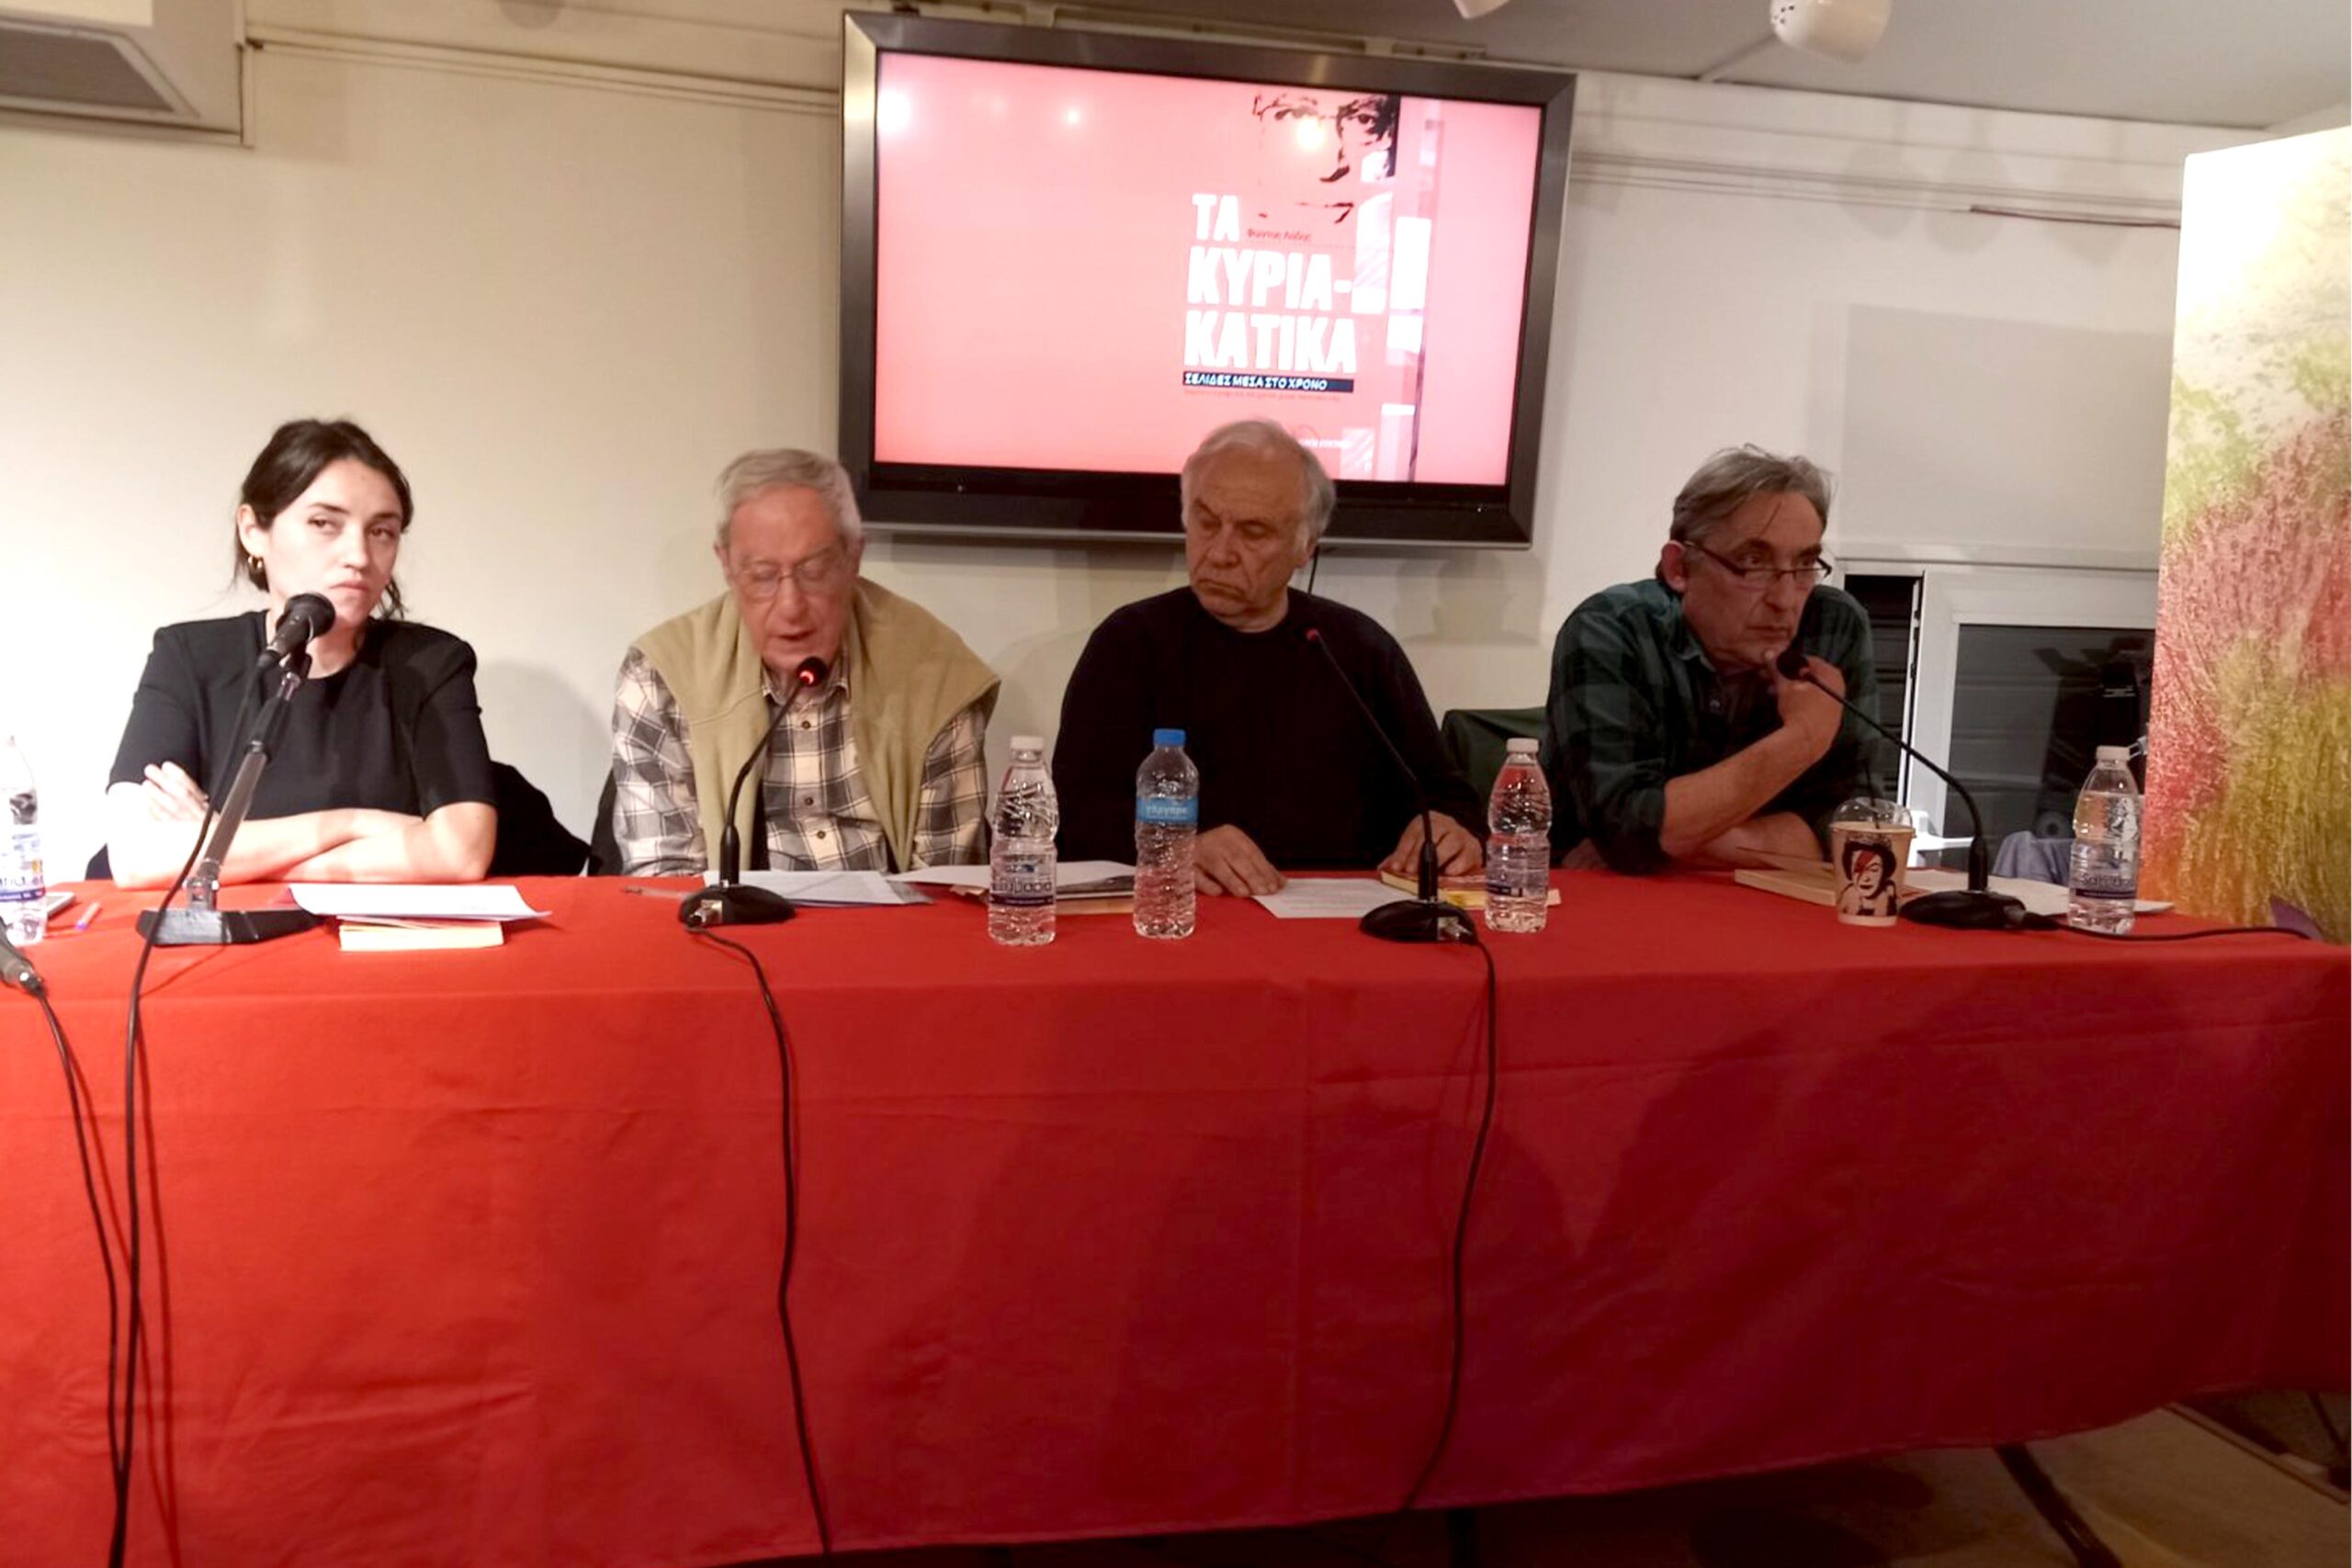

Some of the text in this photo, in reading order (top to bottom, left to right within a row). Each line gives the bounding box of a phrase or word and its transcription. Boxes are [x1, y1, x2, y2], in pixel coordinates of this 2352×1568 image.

[1192, 193, 1240, 242] ΤΑ
[1187, 245, 1352, 311] ΚΥΡΙΑ-
[1184, 310, 1357, 374] ΚΑΤΙΚΑ
[1184, 372, 1328, 390] ΣΕΛΙΔΕΣ ΜΕΣΑ ΣΤΟ ΧΡΟΝΟ
